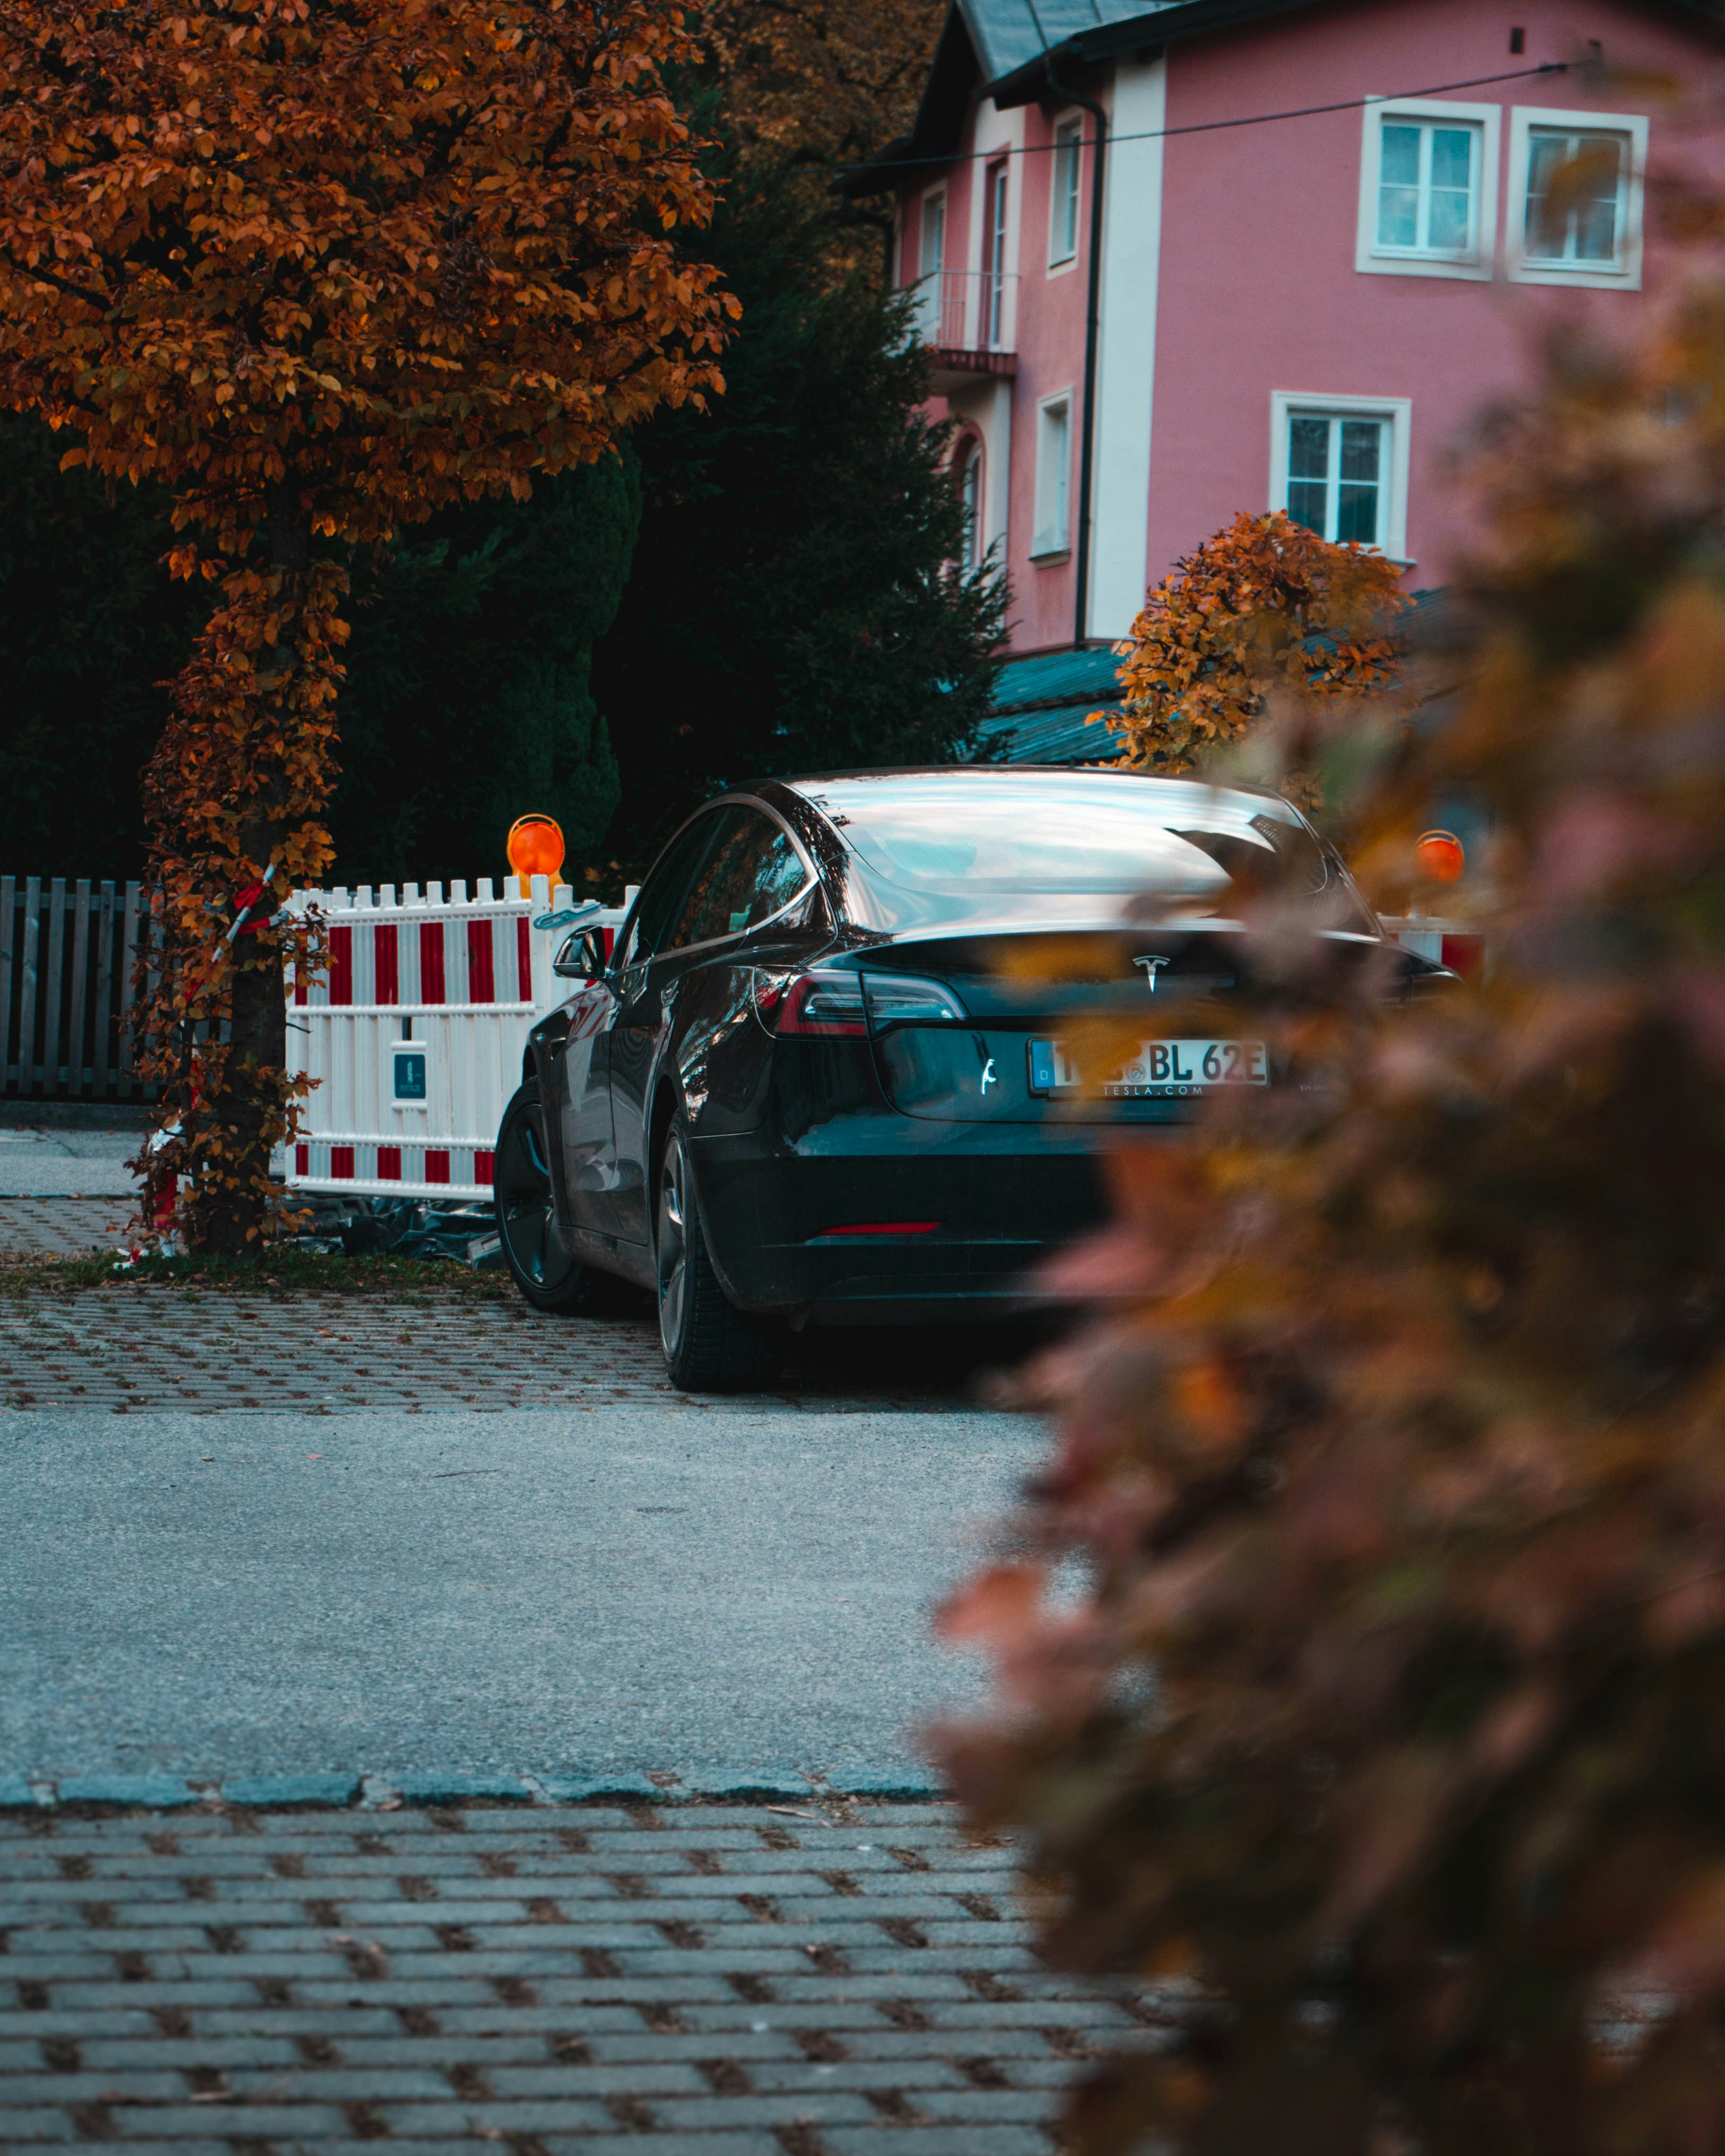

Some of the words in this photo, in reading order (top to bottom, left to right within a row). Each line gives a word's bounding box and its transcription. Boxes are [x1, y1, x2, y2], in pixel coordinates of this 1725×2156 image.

[1149, 1044, 1193, 1080] BL
[1203, 1044, 1265, 1081] 62E
[1040, 1070, 1049, 1080] D
[1104, 1086, 1203, 1096] TESLA.COM
